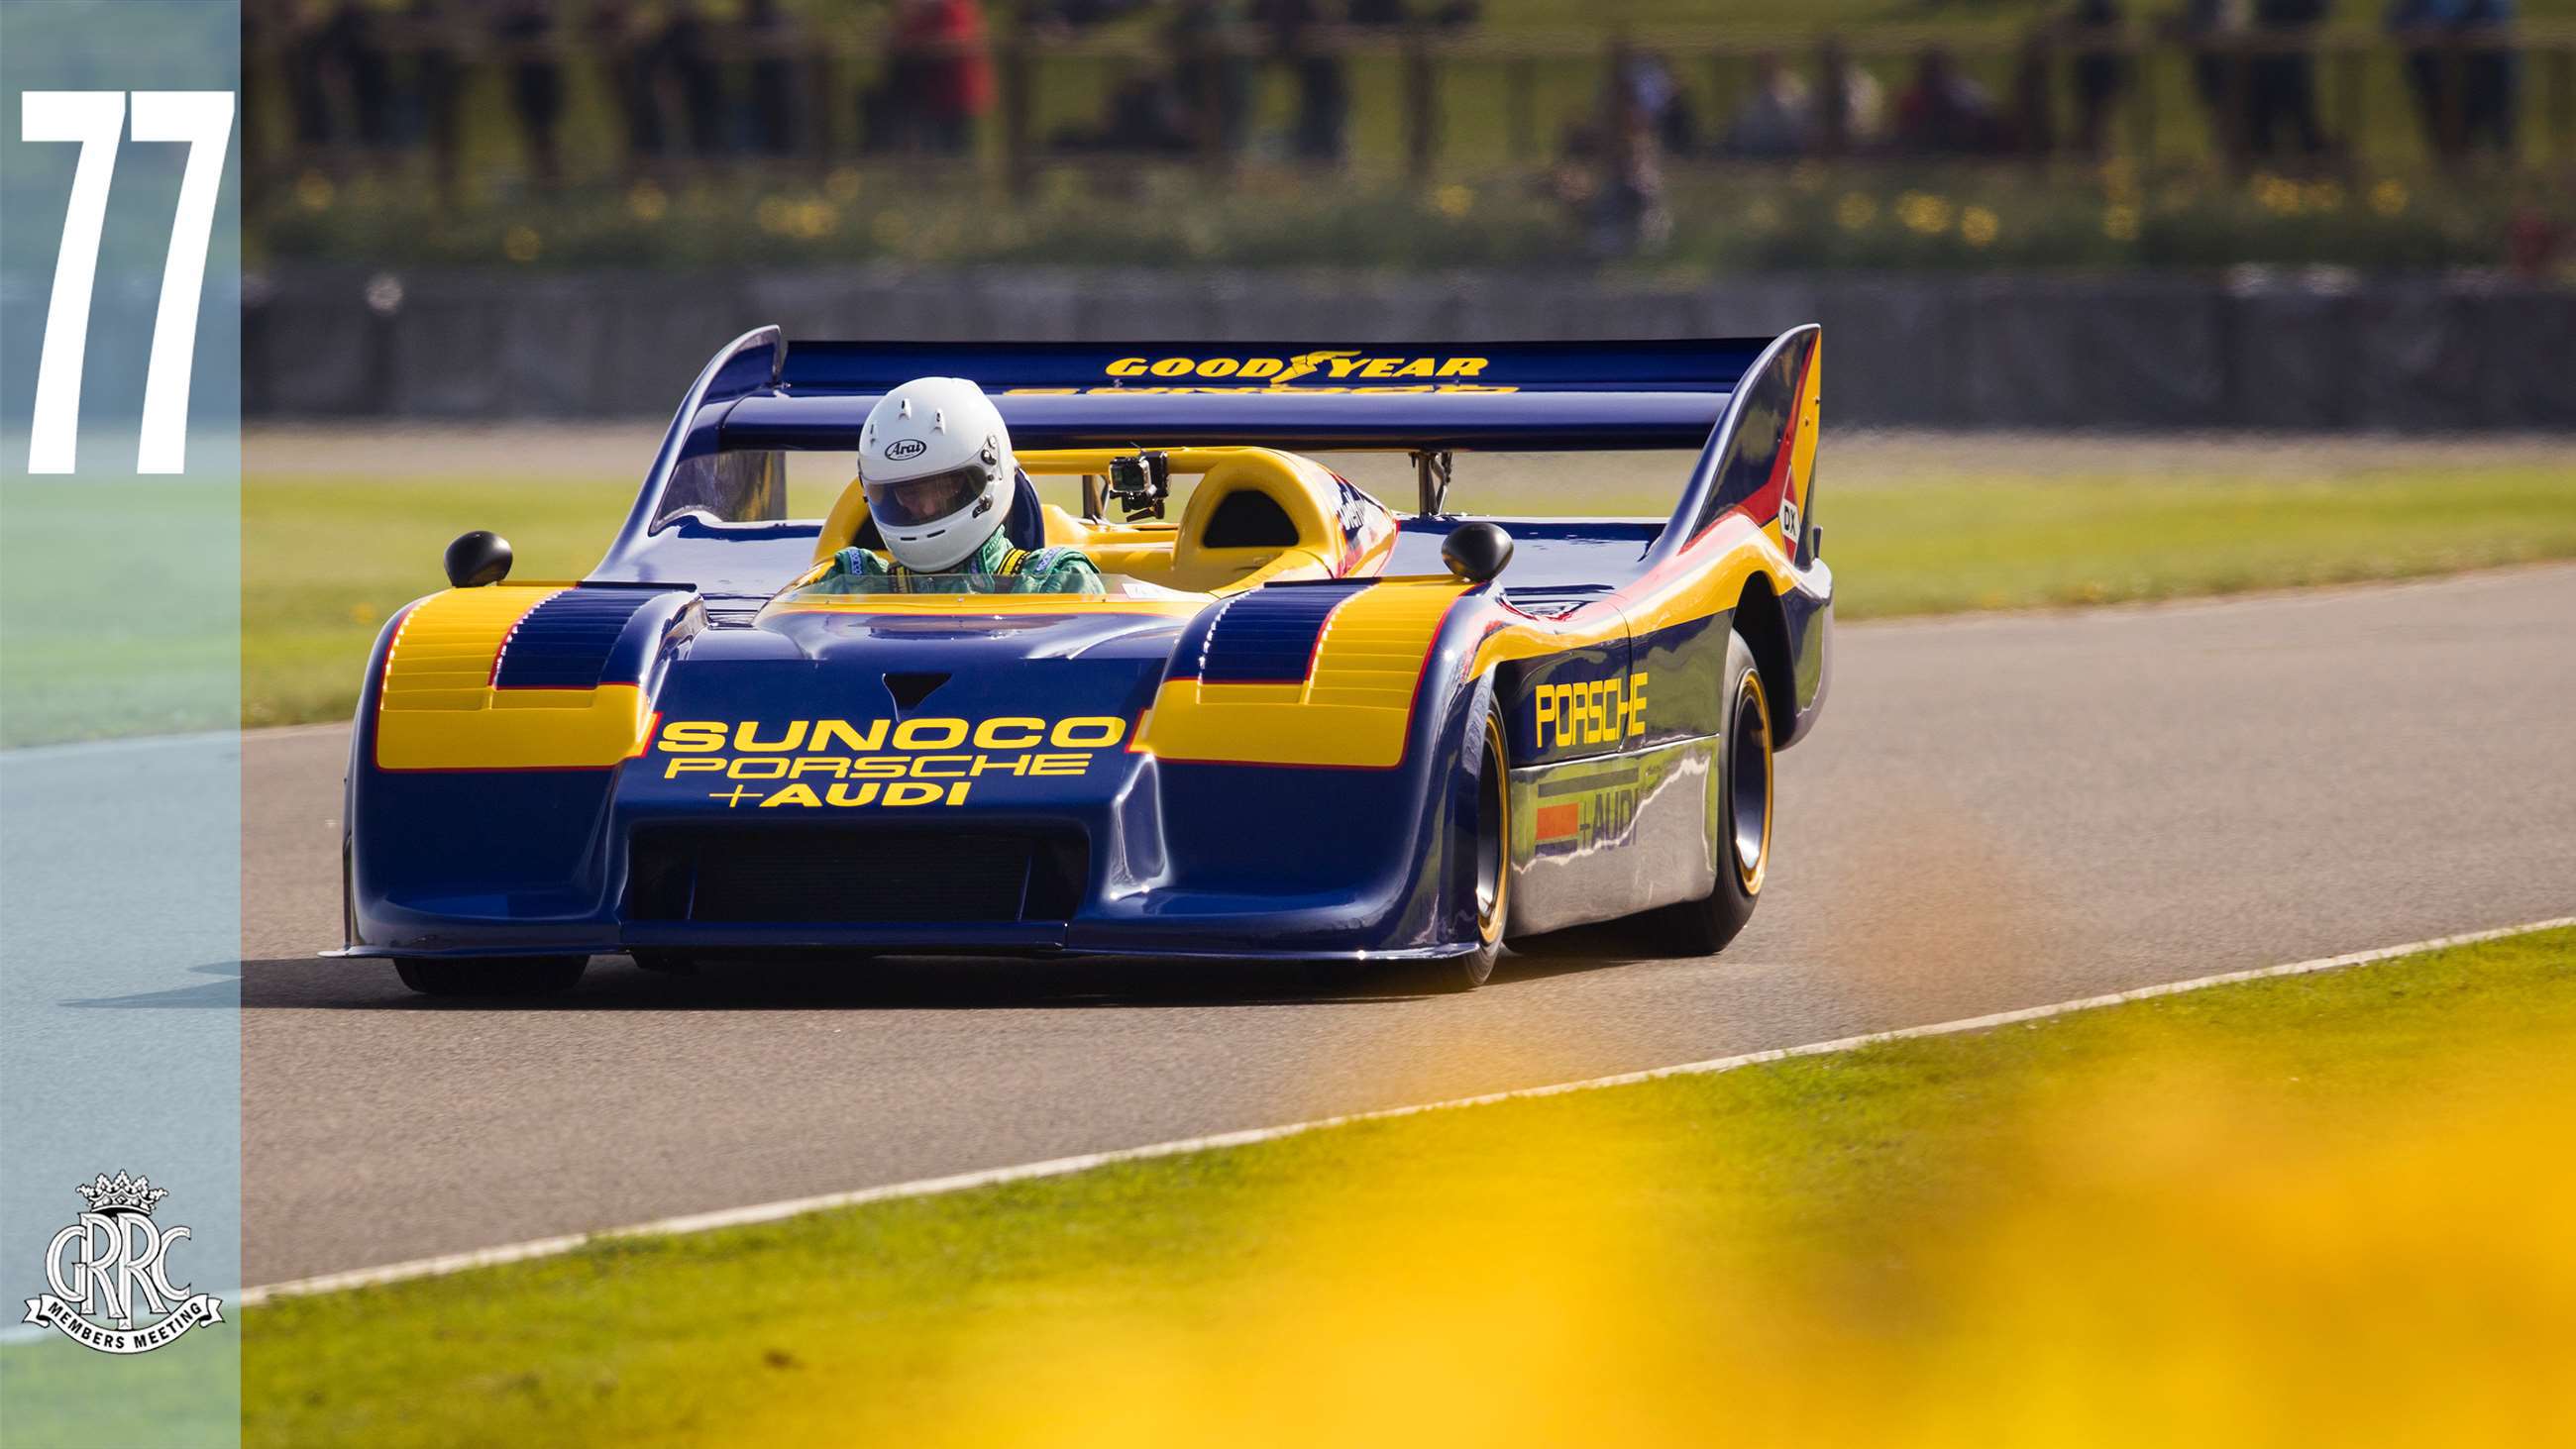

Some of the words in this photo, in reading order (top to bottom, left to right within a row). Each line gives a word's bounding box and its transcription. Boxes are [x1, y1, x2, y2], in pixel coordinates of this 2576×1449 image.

[889, 442, 921, 457] Arai
[1783, 505, 1796, 536] DX
[1536, 672, 1649, 749] PORSCHE
[658, 717, 1127, 752] SUNOCO
[664, 754, 1093, 779] PORSCHE
